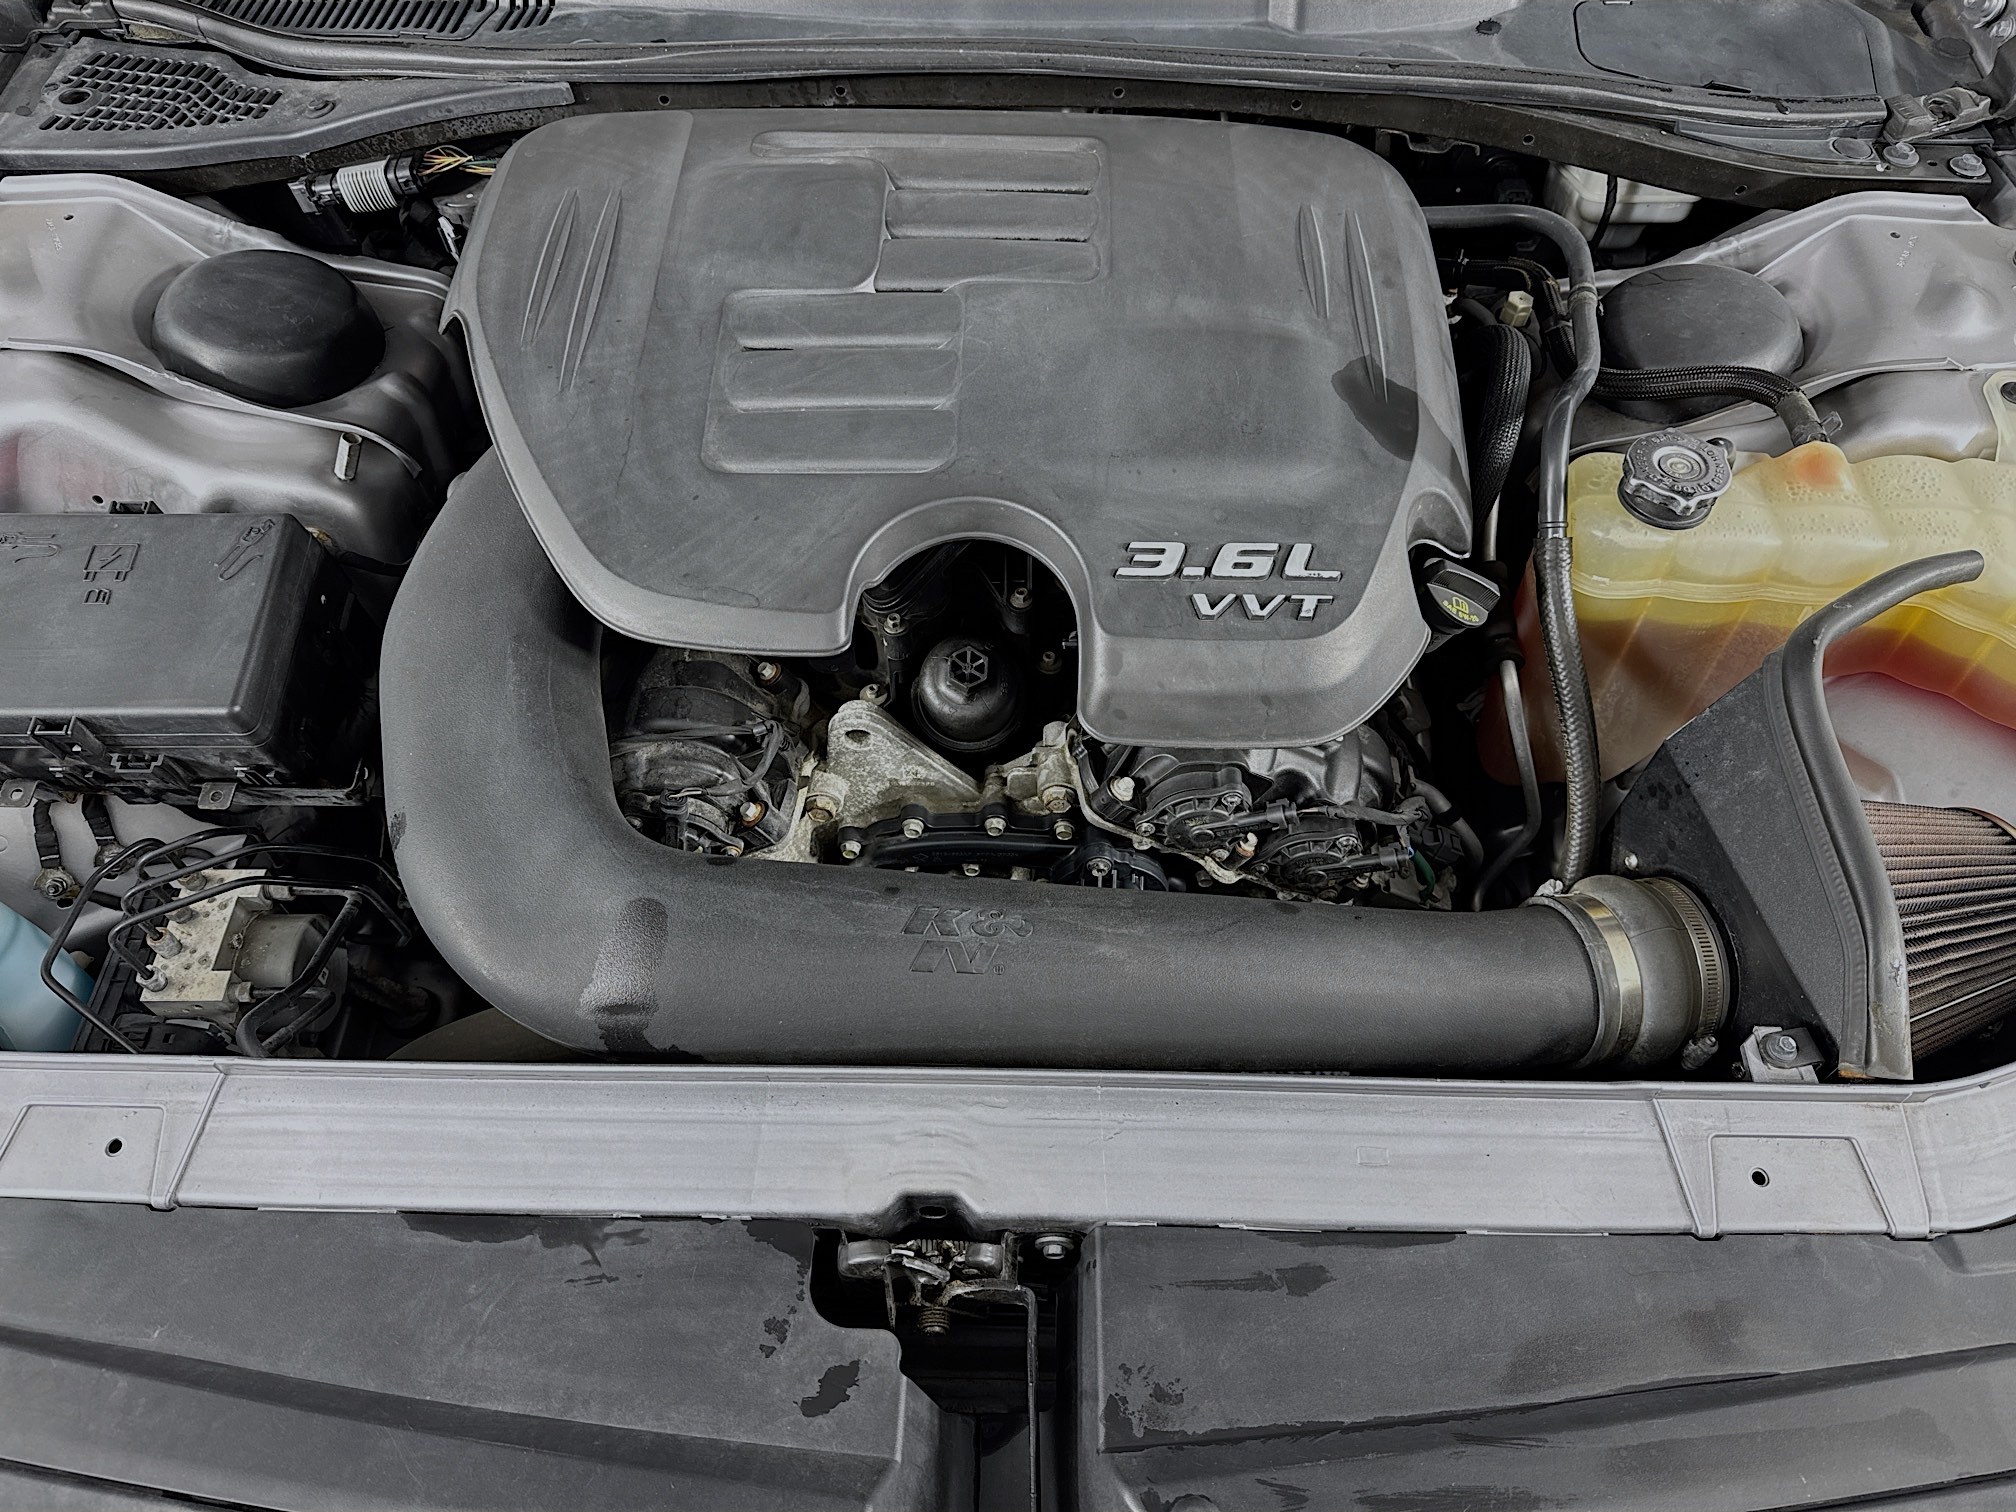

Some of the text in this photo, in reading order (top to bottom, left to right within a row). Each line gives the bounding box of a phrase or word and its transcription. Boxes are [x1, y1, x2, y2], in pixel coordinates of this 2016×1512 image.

[1700, 445, 1719, 463] HOT
[1713, 462, 1726, 485] OPEN
[1114, 541, 1343, 582] 3.6L
[1190, 593, 1334, 622] VVT
